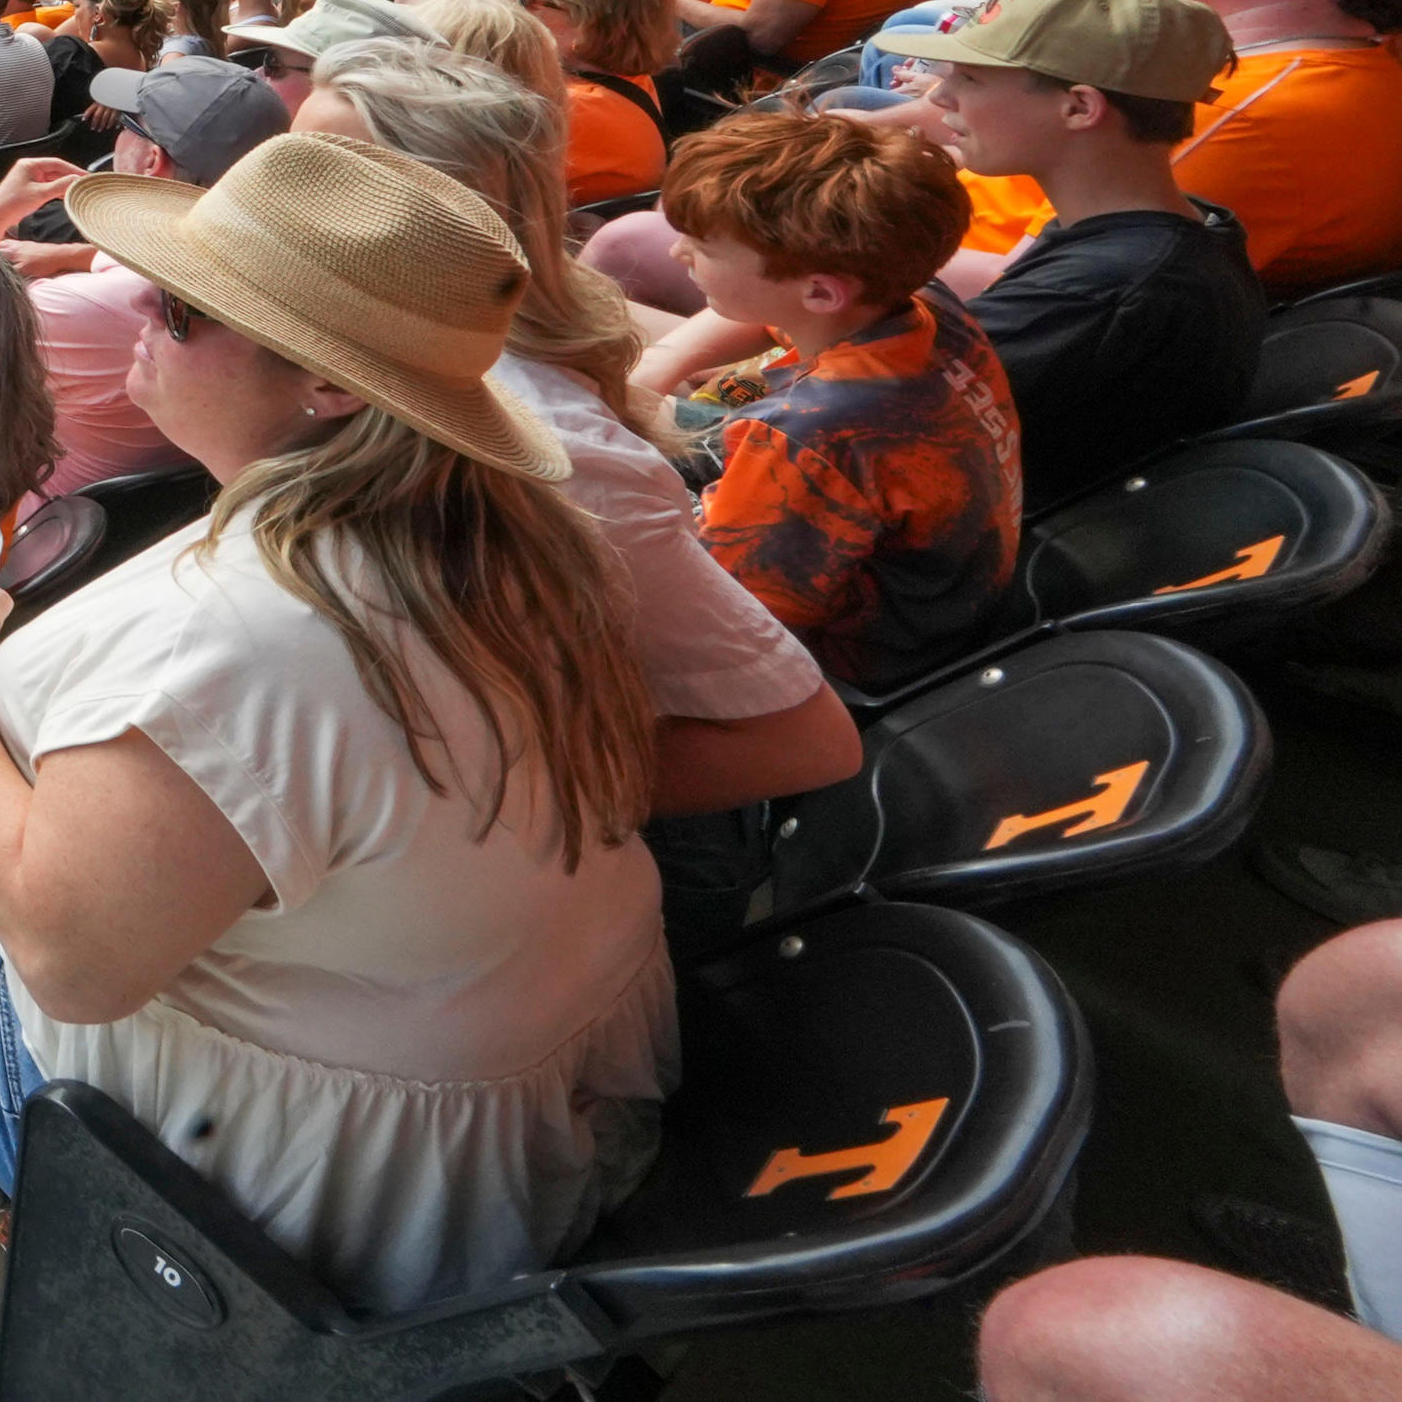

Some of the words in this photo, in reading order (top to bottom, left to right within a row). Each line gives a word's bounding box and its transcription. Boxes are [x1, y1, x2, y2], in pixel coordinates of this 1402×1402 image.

[984, 760, 1151, 851] T
[749, 1097, 950, 1200] T
[154, 1255, 182, 1287] 10
